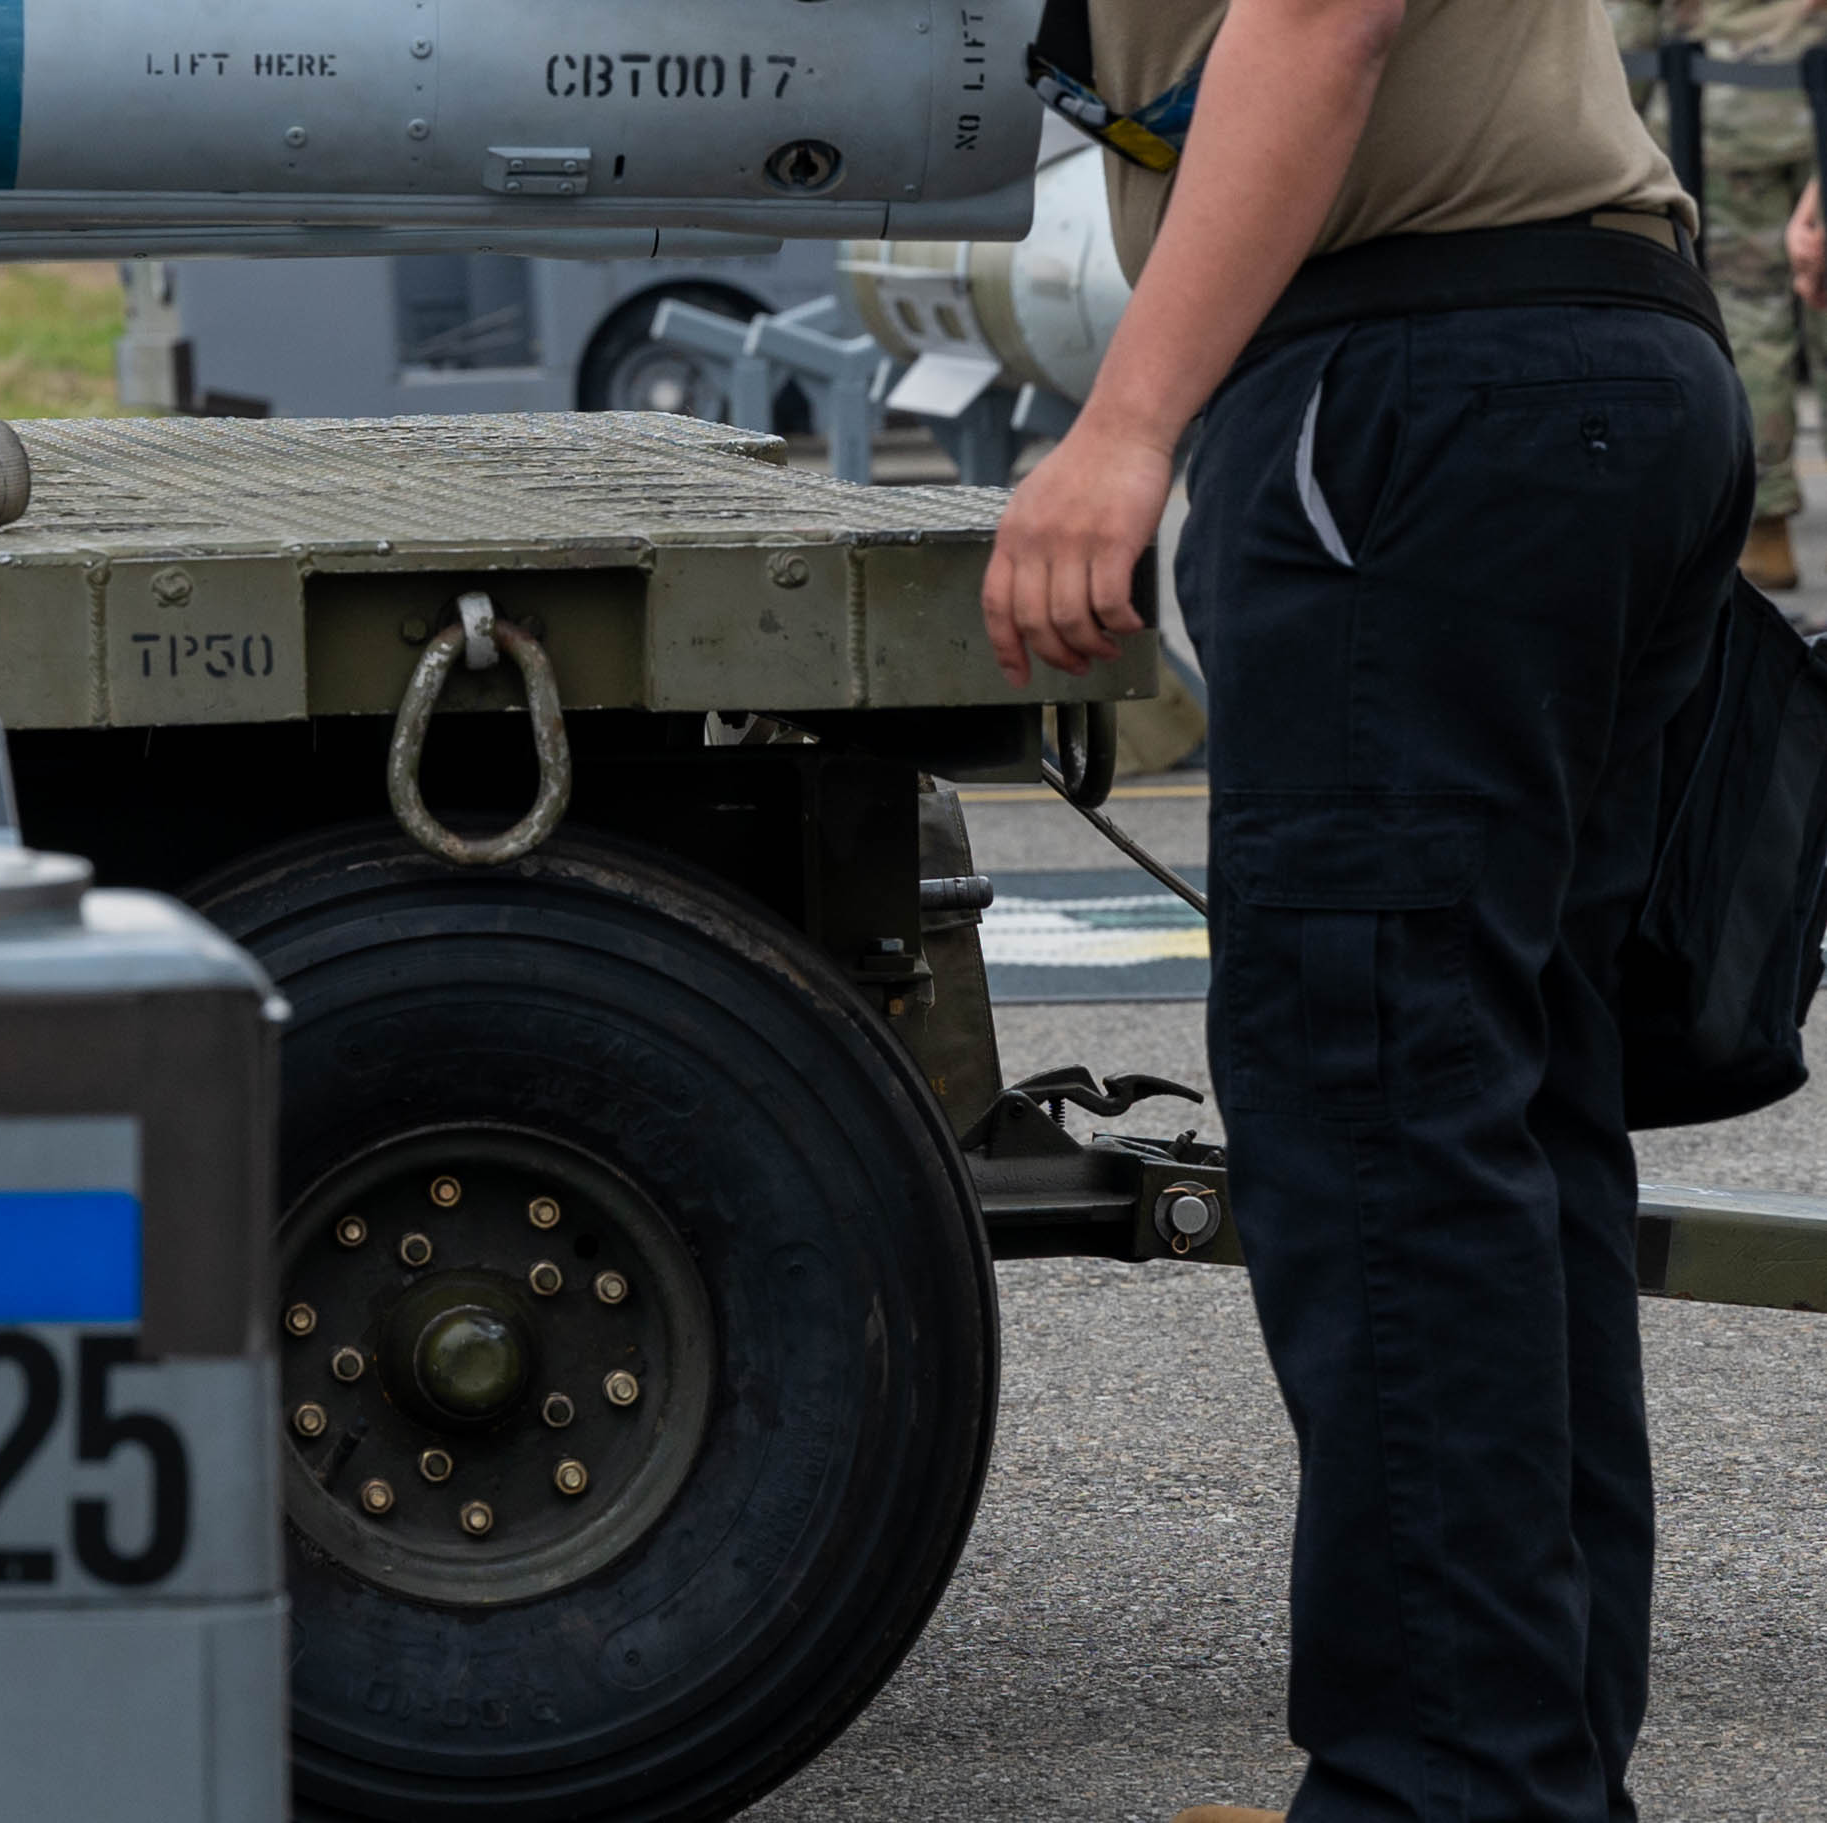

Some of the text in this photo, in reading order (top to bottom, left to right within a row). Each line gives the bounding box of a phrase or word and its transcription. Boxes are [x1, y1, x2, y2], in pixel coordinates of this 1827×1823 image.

[146, 53, 338, 76] LIFT HERE
[546, 54, 797, 99] CBT0017
[954, 9, 986, 151] NO LIFT
[131, 633, 274, 678] TP50
